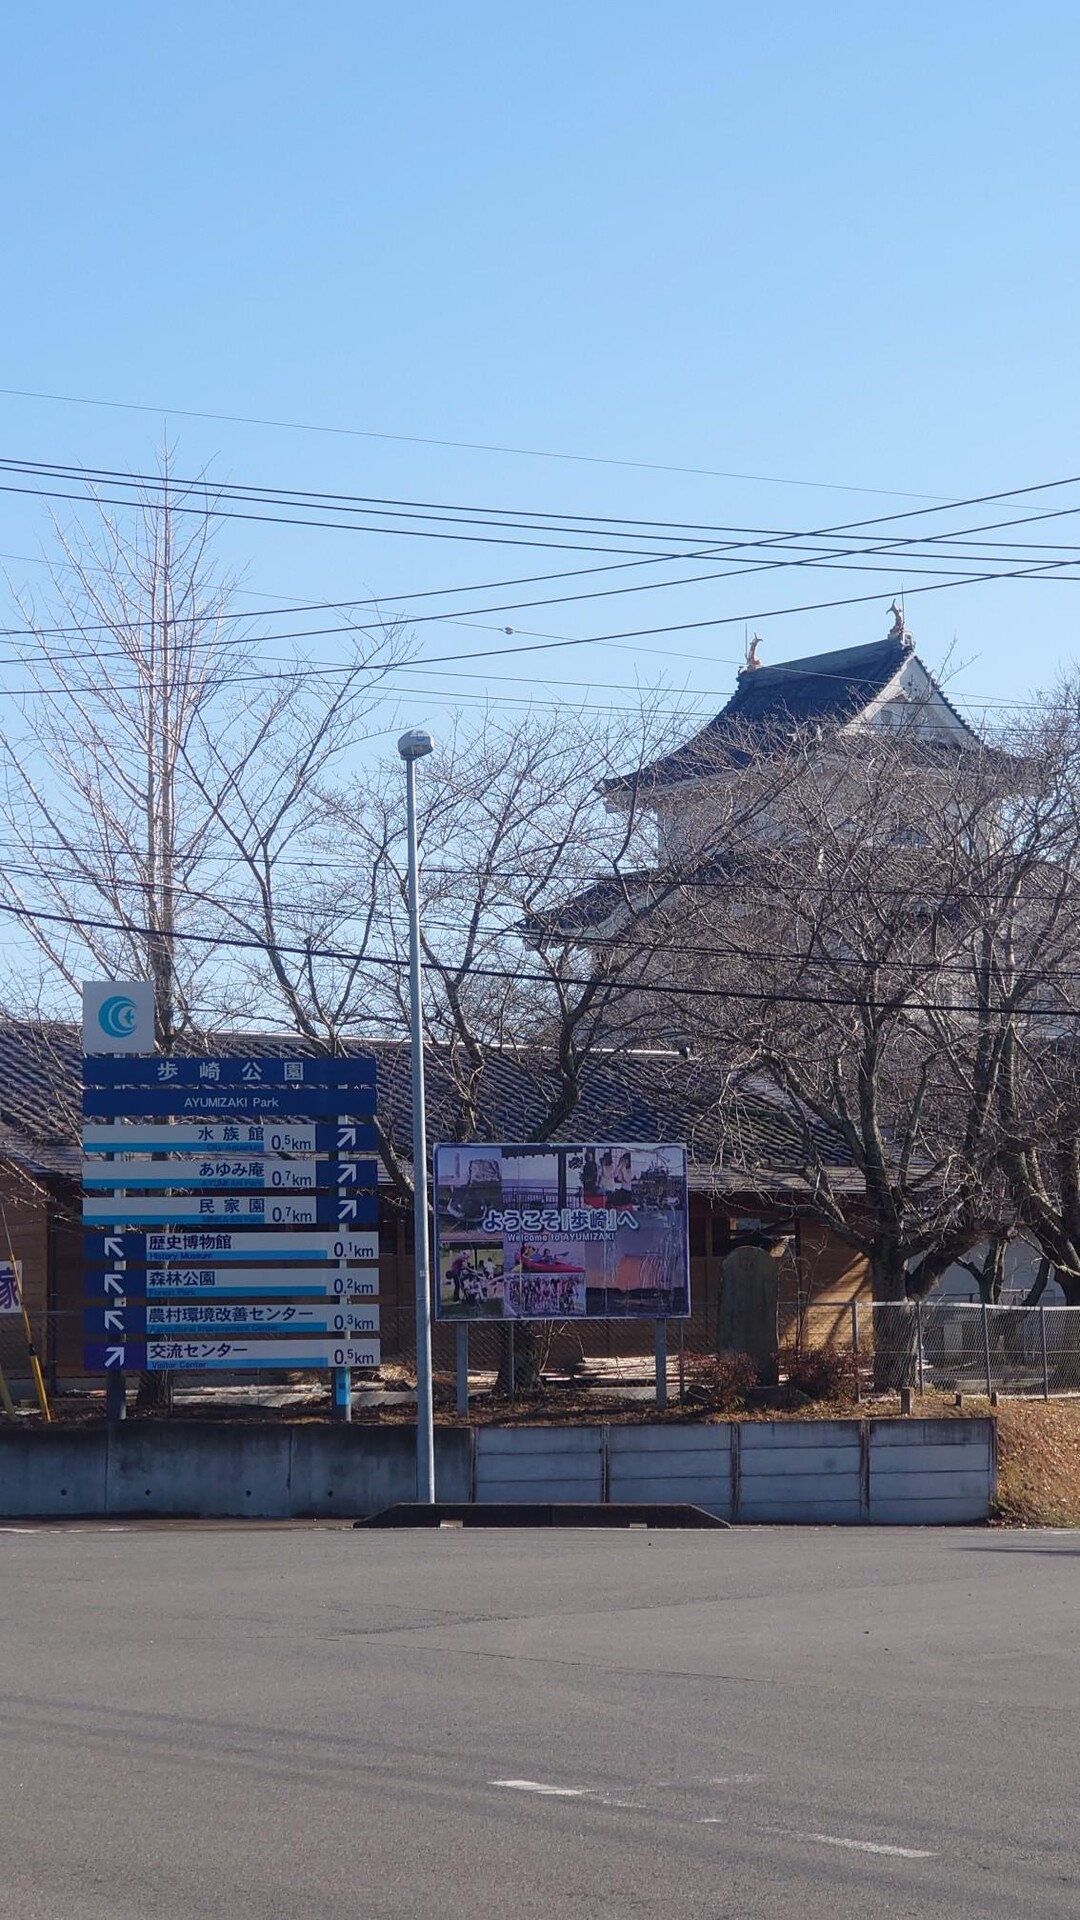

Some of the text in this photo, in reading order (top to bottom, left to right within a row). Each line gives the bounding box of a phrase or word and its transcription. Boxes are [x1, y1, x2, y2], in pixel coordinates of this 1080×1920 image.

[157, 1061, 304, 1081] 歩崎公園
[184, 1097, 279, 1108] AYUMIZAKI Park
[198, 1126, 264, 1141] 水族館
[271, 1135, 312, 1150] 0.5km
[199, 1162, 265, 1177] あゆみ庵
[272, 1171, 312, 1187] 0.7km
[199, 1198, 265, 1213] 民家園
[272, 1207, 313, 1222] 0.7km
[483, 1209, 639, 1231] ようこそ『歩崎』へ
[149, 1234, 232, 1250] 歴史博物館
[507, 1232, 615, 1242] Welcome to AYUMIZAKI
[150, 1251, 213, 1261] History Museum
[333, 1242, 374, 1258] 0.1km
[149, 1271, 216, 1287] 森林公園
[333, 1278, 374, 1294] 0.2km
[149, 1288, 196, 1296] Forest Park
[149, 1306, 313, 1323] 農村環境改善センター
[333, 1314, 374, 1330] 0.3km
[252, 1323, 279, 1332] Center
[149, 1343, 248, 1359] 交流センター
[334, 1348, 374, 1365] 0.5km
[151, 1360, 206, 1369] Visitor Center
